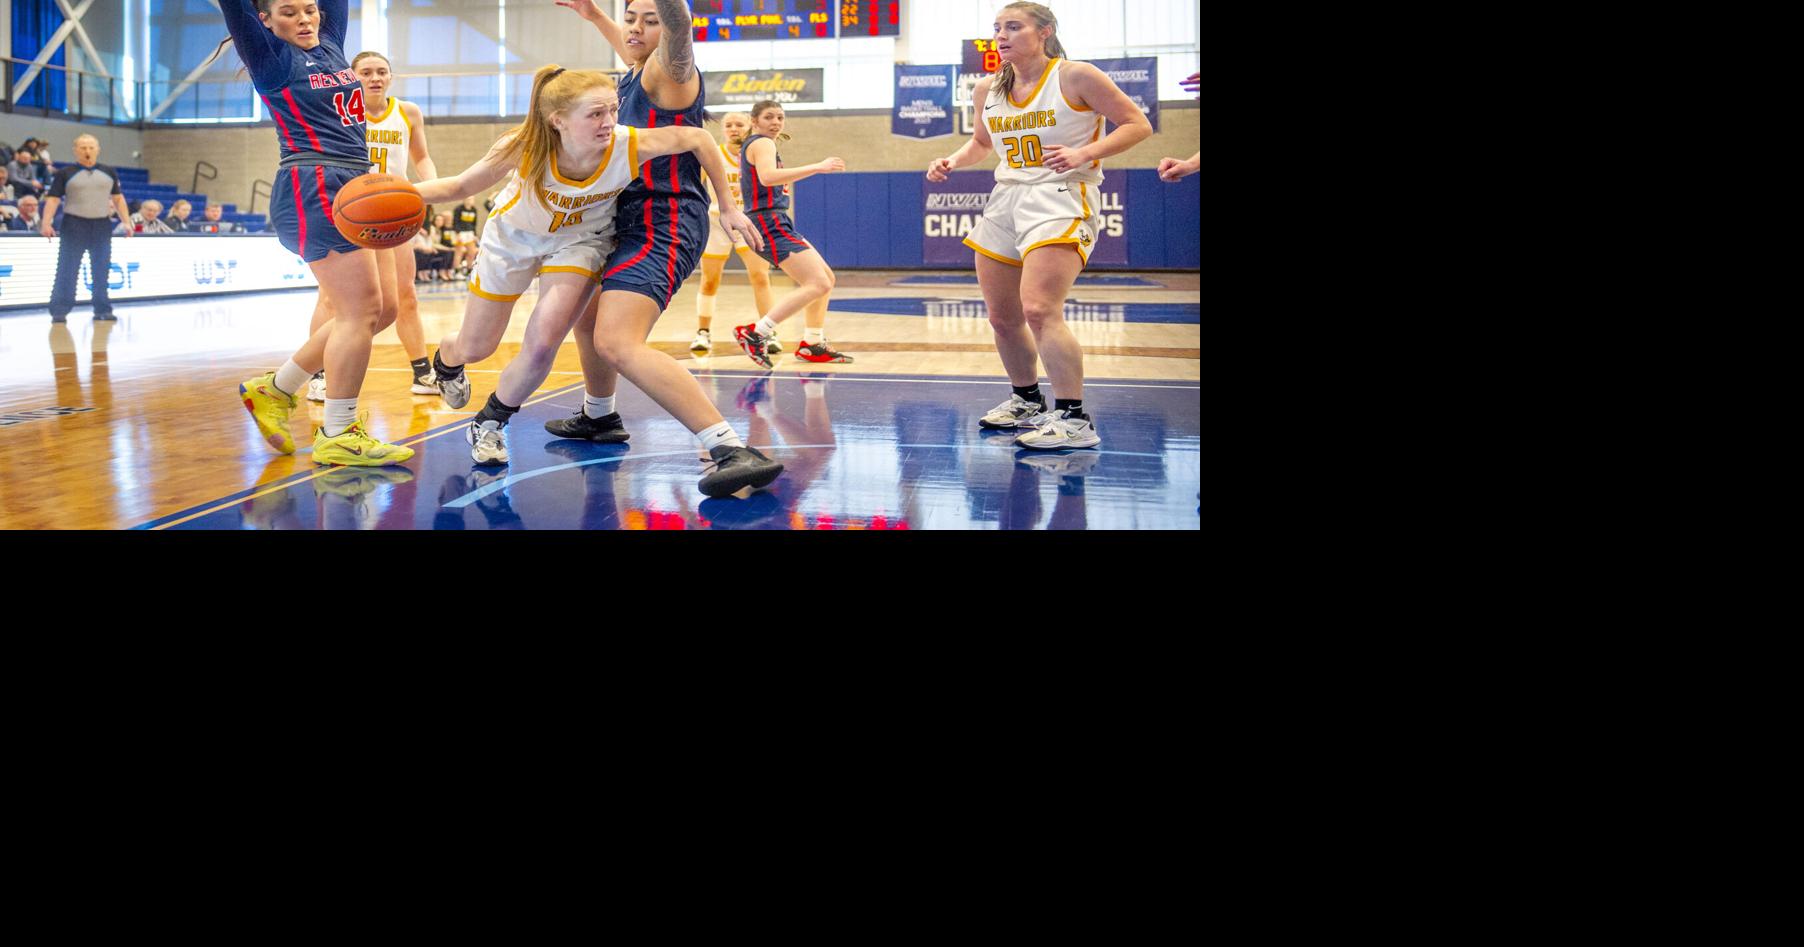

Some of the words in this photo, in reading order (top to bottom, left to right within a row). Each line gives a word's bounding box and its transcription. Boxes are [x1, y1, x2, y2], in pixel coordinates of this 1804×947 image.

[983, 50, 1000, 72] 8
[332, 87, 366, 127] 14
[987, 110, 1057, 133] WARRIORS
[1002, 134, 1044, 168] 20
